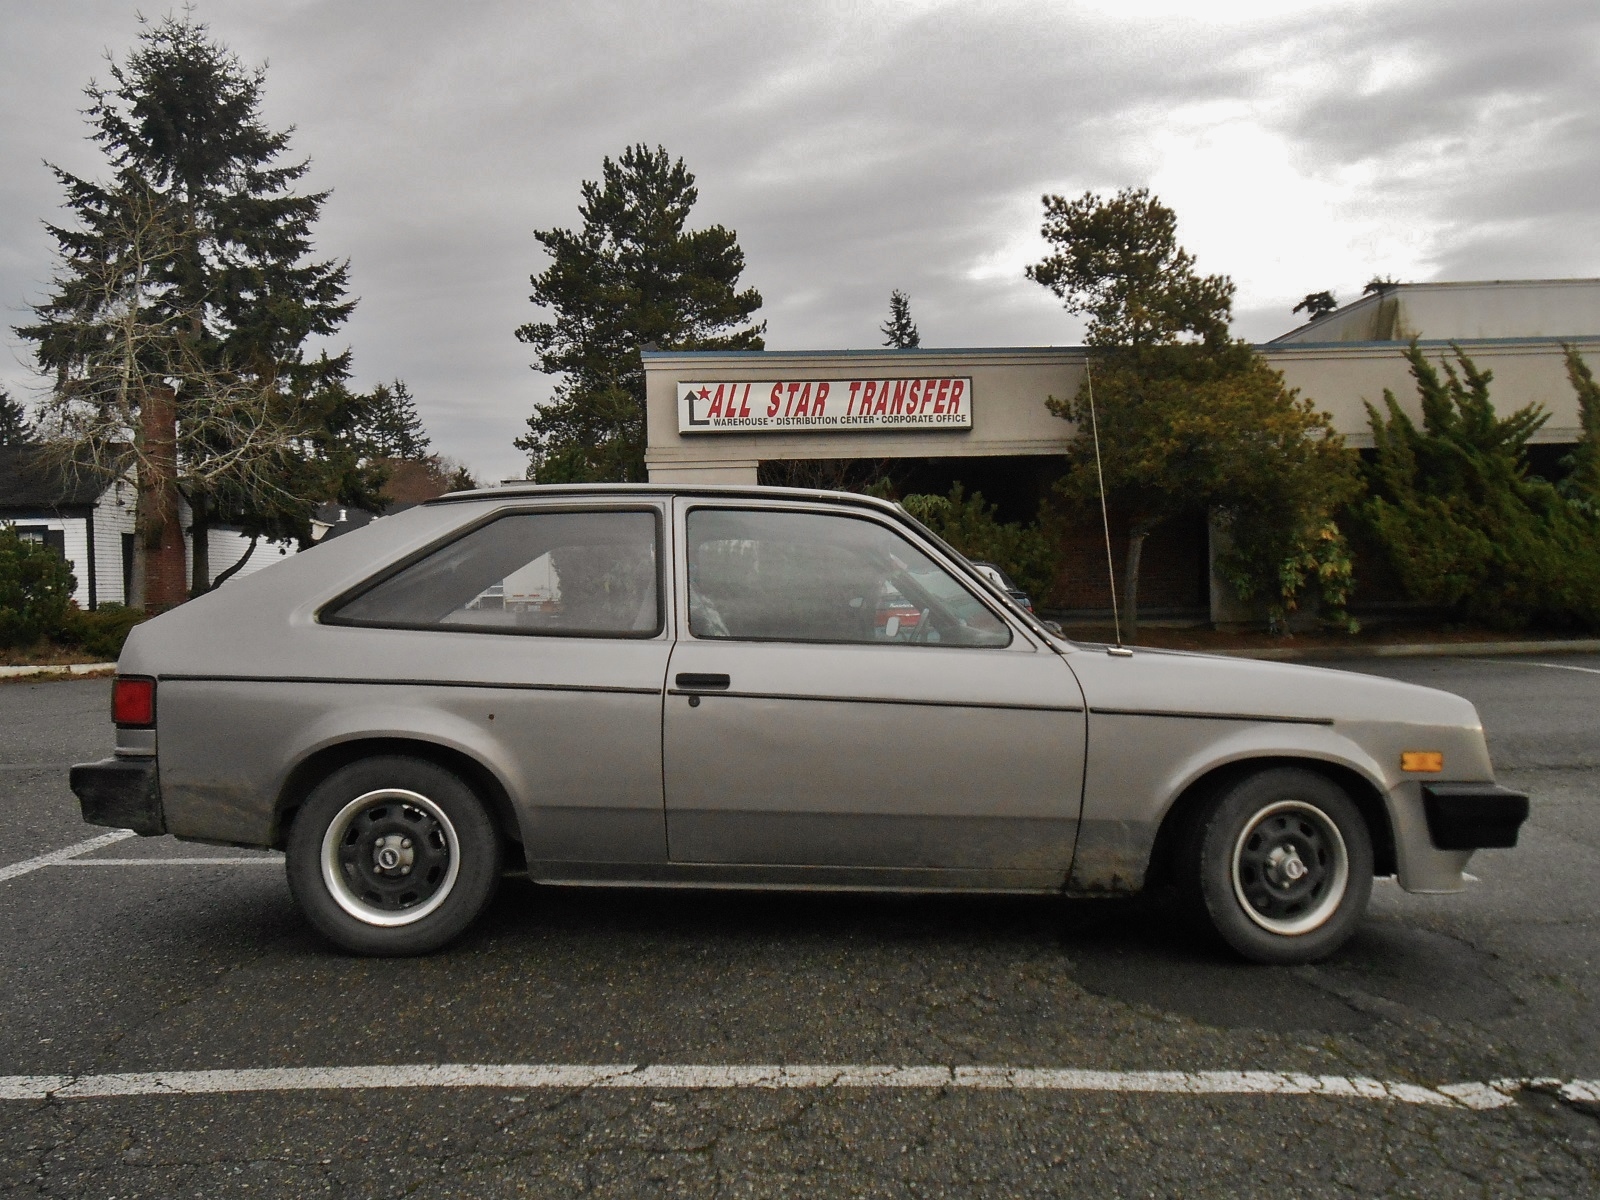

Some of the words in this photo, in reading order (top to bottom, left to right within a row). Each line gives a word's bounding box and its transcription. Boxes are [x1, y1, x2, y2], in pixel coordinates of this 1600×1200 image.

[707, 384, 751, 418] ALL
[767, 382, 830, 417] STAR
[846, 380, 964, 415] TRANSFER
[713, 417, 768, 426] WAREHOUSE
[776, 416, 837, 425] DISTRIBUTION
[840, 415, 875, 424] CENTER
[881, 415, 933, 423] CORPORATE
[936, 414, 967, 422] OFFICE
